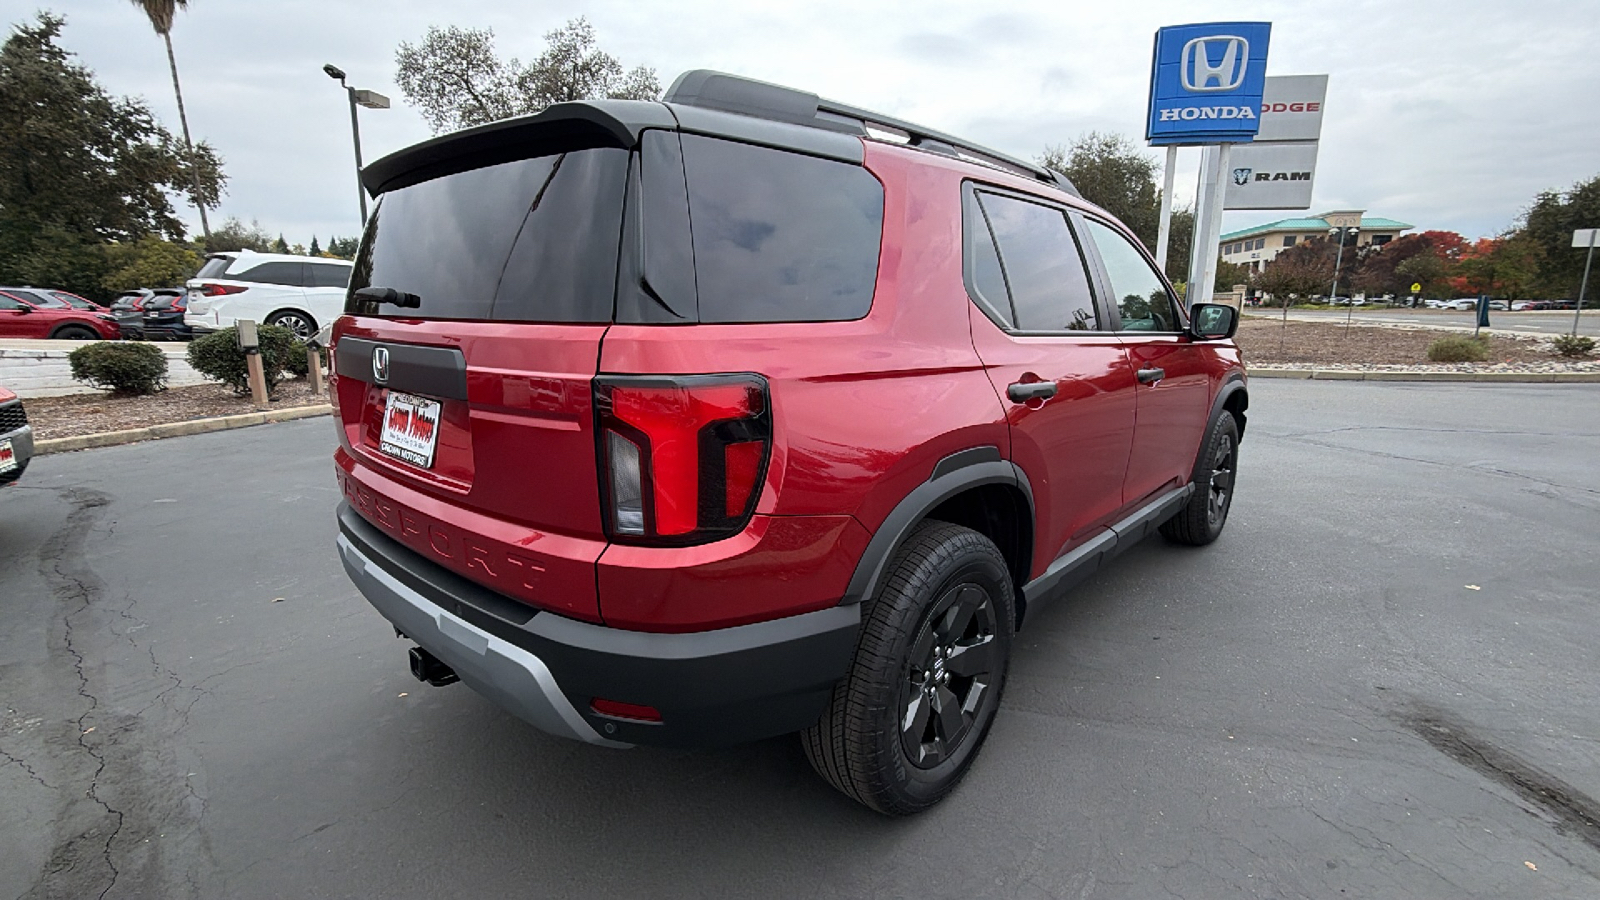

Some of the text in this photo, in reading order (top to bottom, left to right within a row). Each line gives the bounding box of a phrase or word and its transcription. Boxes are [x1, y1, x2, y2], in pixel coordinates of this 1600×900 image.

[1159, 106, 1256, 121] HONDA
[1261, 102, 1320, 113] ODGE
[1254, 171, 1311, 181] RAM
[397, 393, 426, 407] REDDING
[381, 442, 425, 466] CROWN MOTORS
